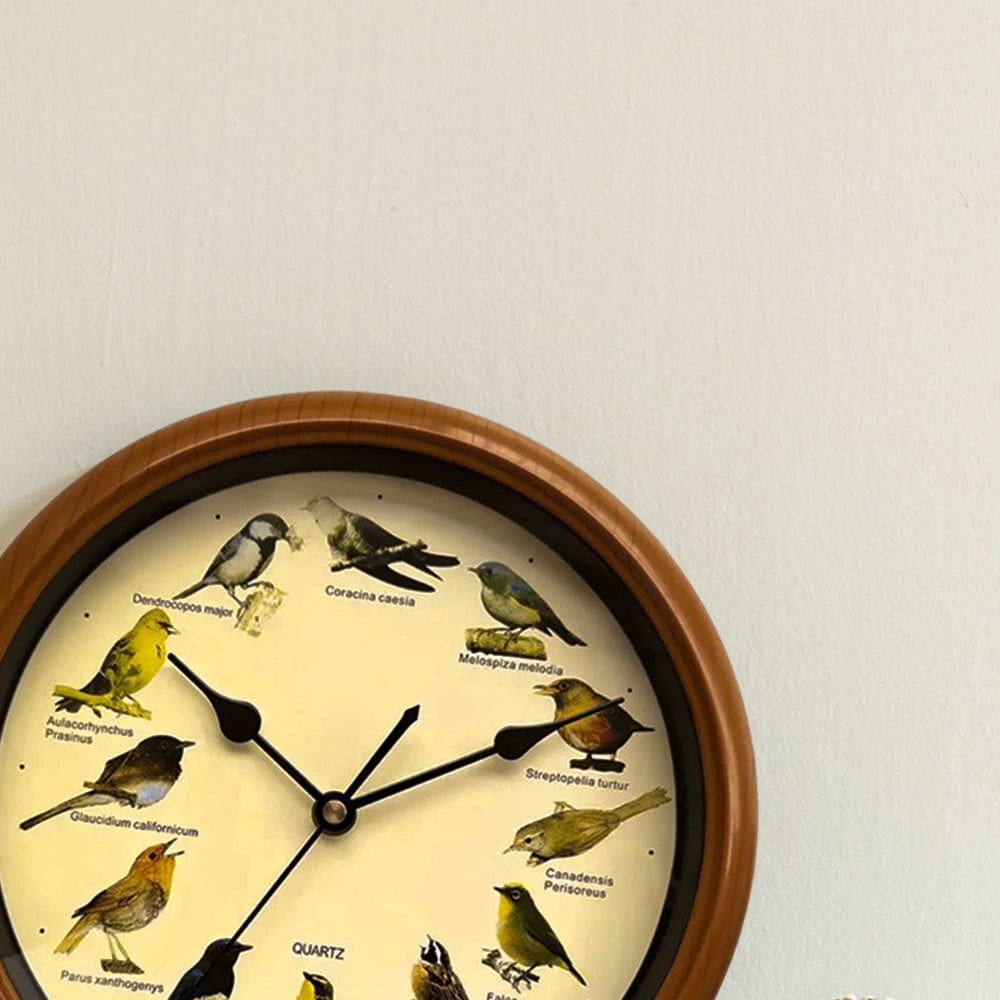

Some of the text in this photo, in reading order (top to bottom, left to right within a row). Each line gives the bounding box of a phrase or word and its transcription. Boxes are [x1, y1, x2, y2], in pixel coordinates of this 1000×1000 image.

[132, 593, 234, 619] Dendrocopos major
[325, 584, 416, 607] Coracina caesia
[458, 652, 563, 676] Melospiza melodia
[45, 727, 93, 745] Prasinus
[46, 715, 134, 737] Aulacorhynchus
[526, 768, 630, 791] Streptopelia turtur
[70, 810, 199, 838] Glaucidium californicum
[545, 867, 614, 887] Canadensis
[543, 880, 607, 899] Perisoreus
[291, 941, 345, 961] QUARTZ
[60, 969, 164, 995] Parus xanthogenys
